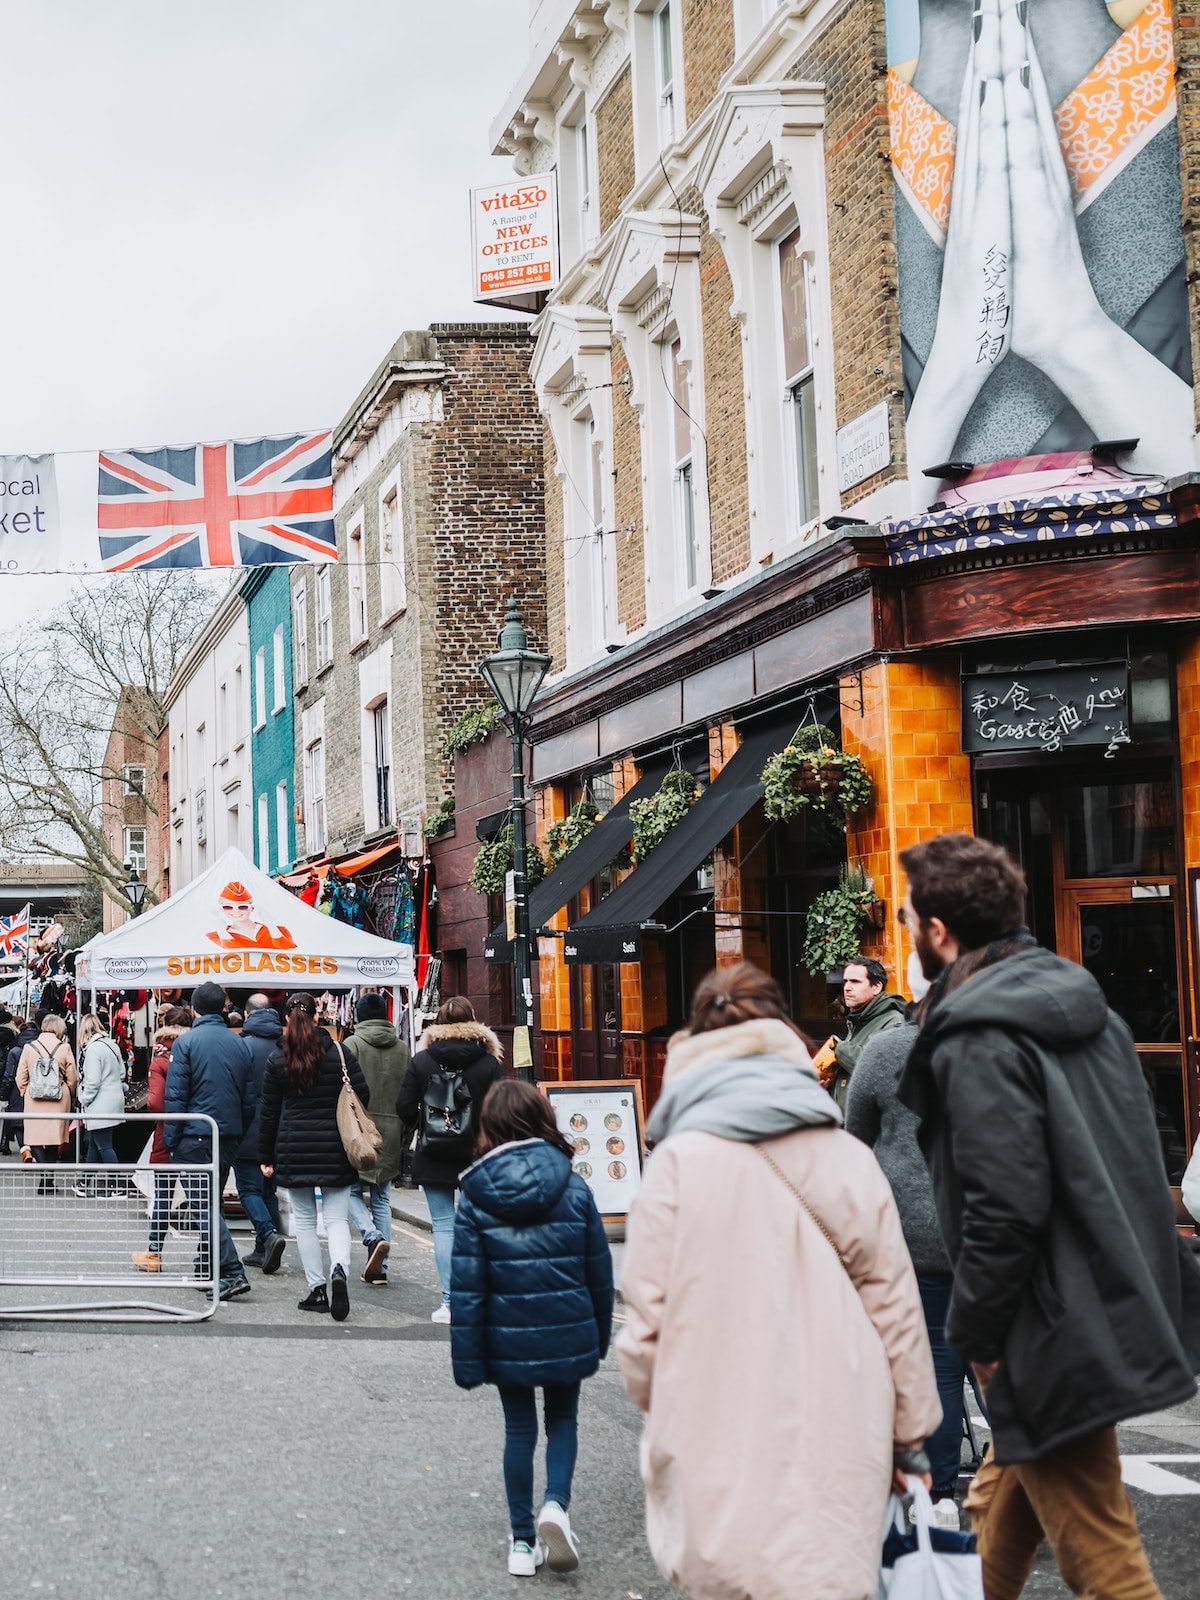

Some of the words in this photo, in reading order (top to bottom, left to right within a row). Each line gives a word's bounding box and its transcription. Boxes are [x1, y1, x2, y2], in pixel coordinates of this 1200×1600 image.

[480, 187, 548, 212] vitaxo
[491, 218, 498, 226] A
[500, 214, 527, 226] Range
[528, 211, 538, 220] of
[496, 223, 533, 240] NEW
[481, 235, 549, 257] OFFICES
[495, 256, 509, 266] TO
[510, 252, 535, 264] RENT
[481, 271, 505, 283] 0845
[506, 267, 524, 279] 257
[526, 262, 550, 275] 8612
[840, 431, 885, 471] PORTOBELLO
[843, 463, 865, 488] ROAD
[111, 960, 130, 968] 100%
[166, 952, 339, 976] SUNGLASSES
